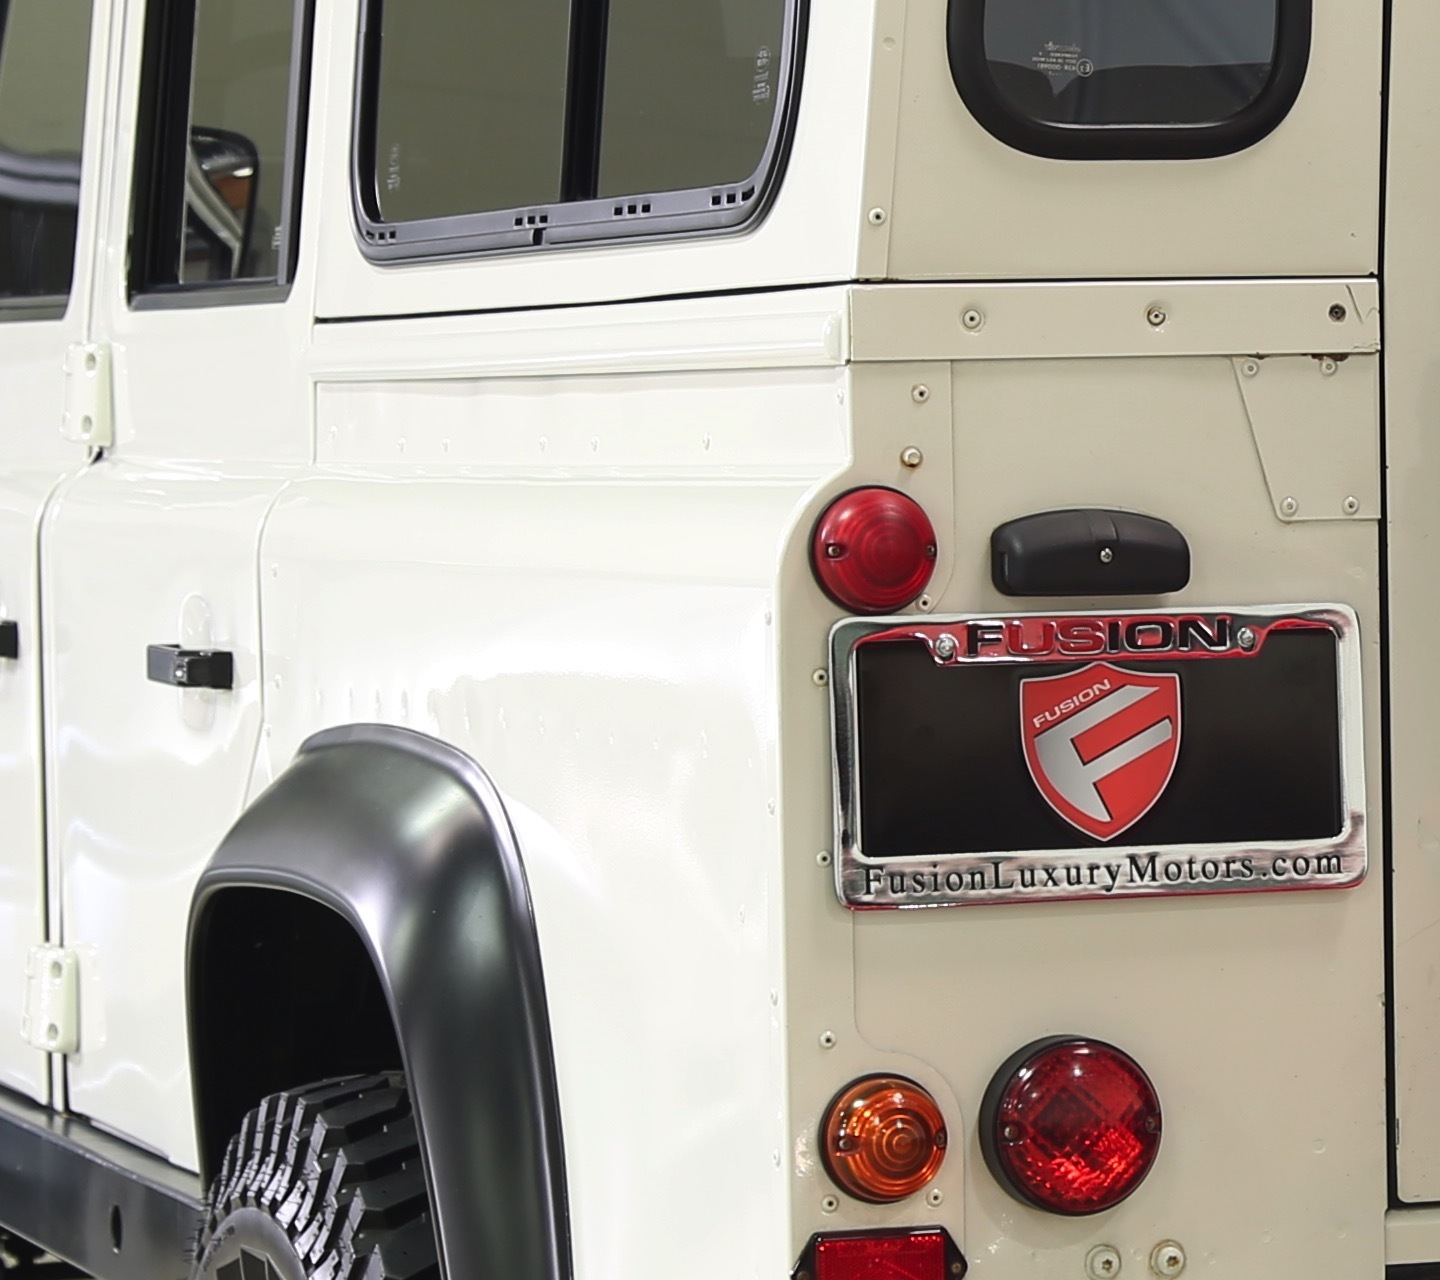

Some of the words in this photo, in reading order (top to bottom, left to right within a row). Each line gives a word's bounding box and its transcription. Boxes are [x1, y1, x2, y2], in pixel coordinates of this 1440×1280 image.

[965, 615, 1231, 657] FUSION
[1032, 679, 1112, 728] FUSION
[861, 849, 1344, 896] FusionLuxuryMotors.com
